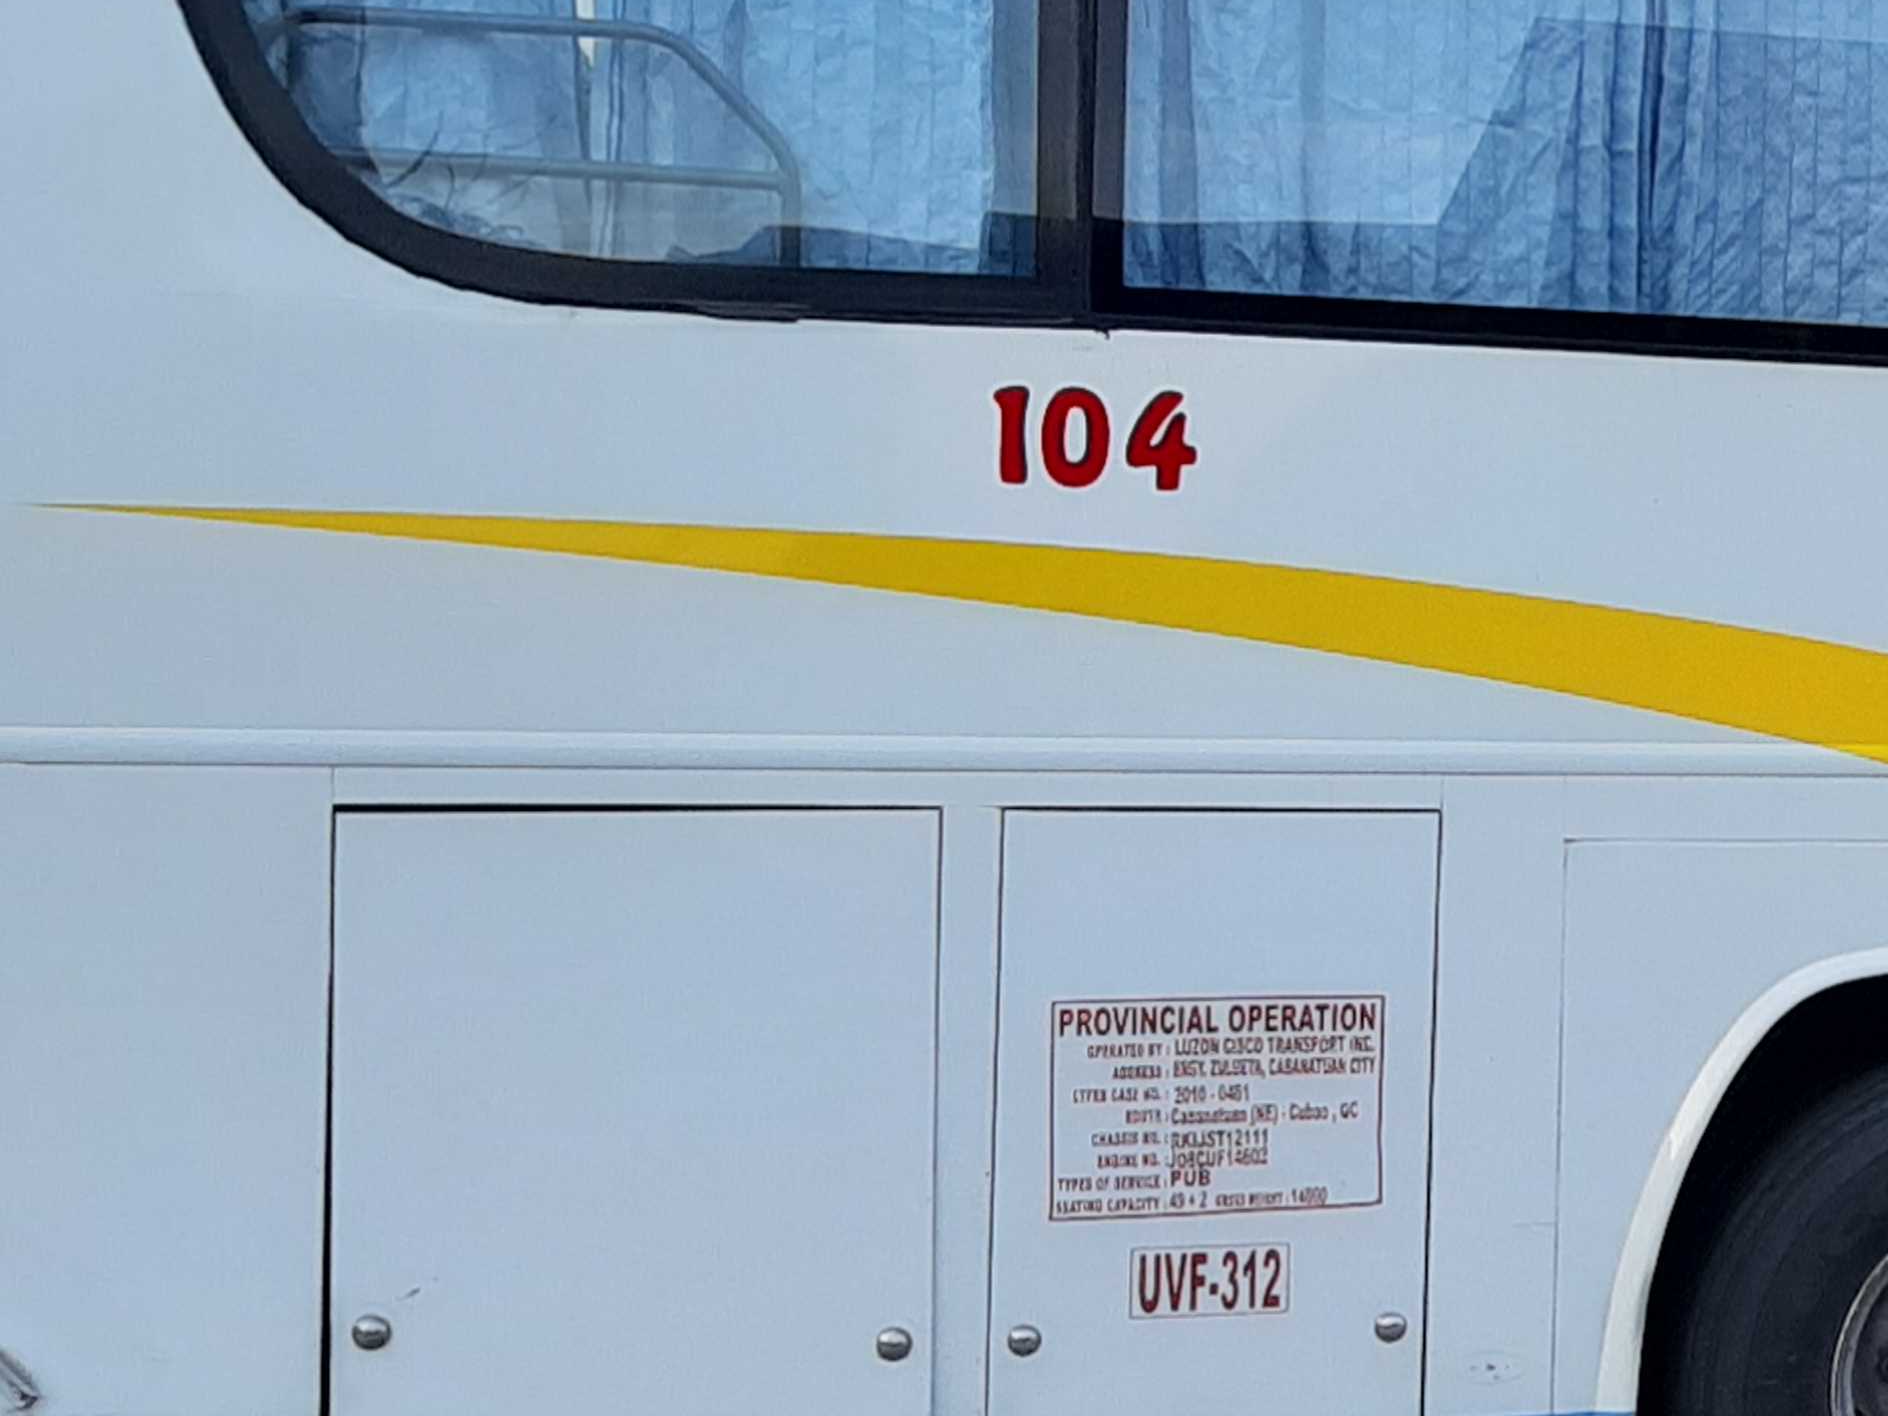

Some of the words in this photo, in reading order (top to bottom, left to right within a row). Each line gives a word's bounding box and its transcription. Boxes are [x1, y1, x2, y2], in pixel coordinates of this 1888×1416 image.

[993, 385, 1198, 491] 104
[1059, 1005, 1219, 1037] PROVINCIAL
[1228, 1002, 1376, 1033] OPERATION
[1149, 1043, 1163, 1057] BY
[1175, 1038, 1219, 1055] LUZON
[1223, 1037, 1264, 1054] CISCO
[1268, 1036, 1346, 1054] TRANSPORT
[1112, 1065, 1161, 1080] ADDRESS
[1269, 1057, 1345, 1075] CABANATUAN
[1350, 1056, 1375, 1074] CITY
[1170, 1169, 1211, 1187] PUB
[1200, 1190, 1207, 1209] 2
[1138, 1248, 1281, 1315] UVF-312
